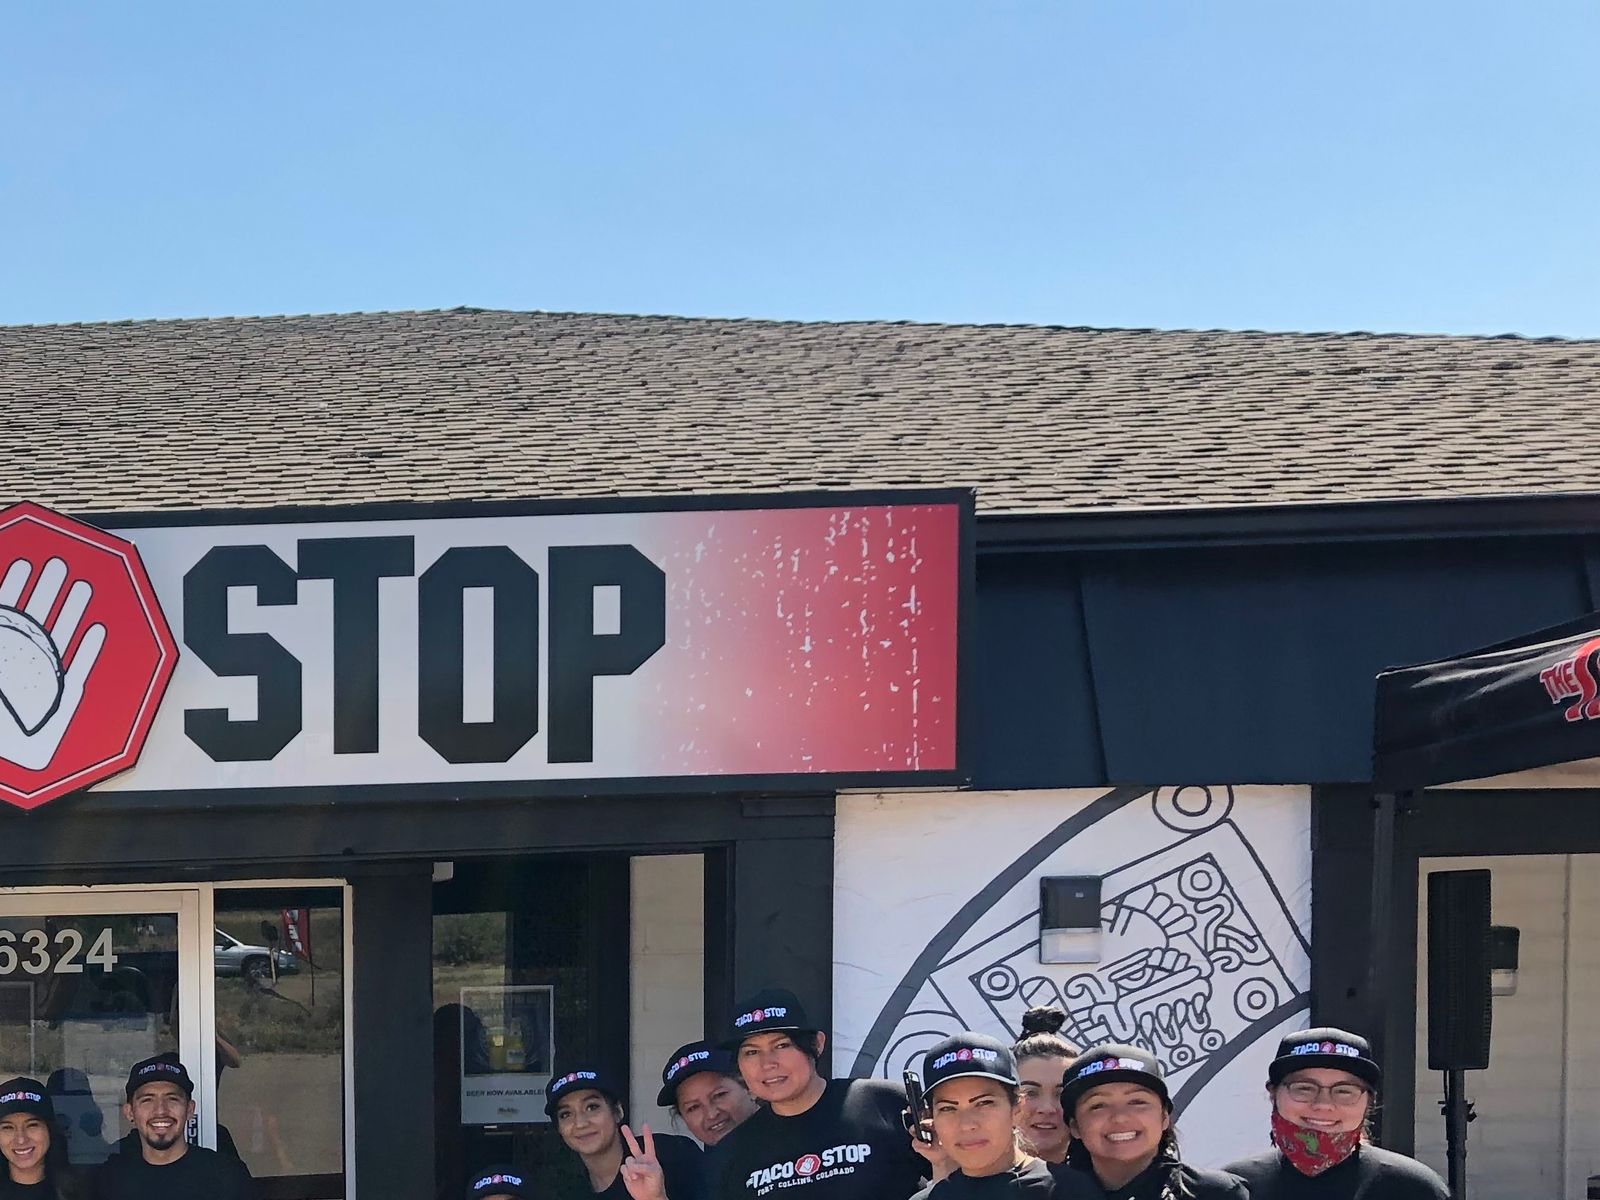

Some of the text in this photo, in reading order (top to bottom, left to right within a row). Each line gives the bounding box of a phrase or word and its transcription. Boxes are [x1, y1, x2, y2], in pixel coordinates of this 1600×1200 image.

[183, 535, 666, 764] STOP
[1540, 660, 1582, 704] THE
[764, 1007, 787, 1018] STOP
[688, 1051, 710, 1062] STOP
[934, 1048, 998, 1070] TACO STOP
[1294, 1042, 1320, 1055] TACO
[577, 1071, 597, 1080] STOP
[750, 1161, 794, 1188] TACO
[821, 1144, 871, 1167] STOP
[757, 1166, 855, 1197] FORT COLLINS, COLORADO
